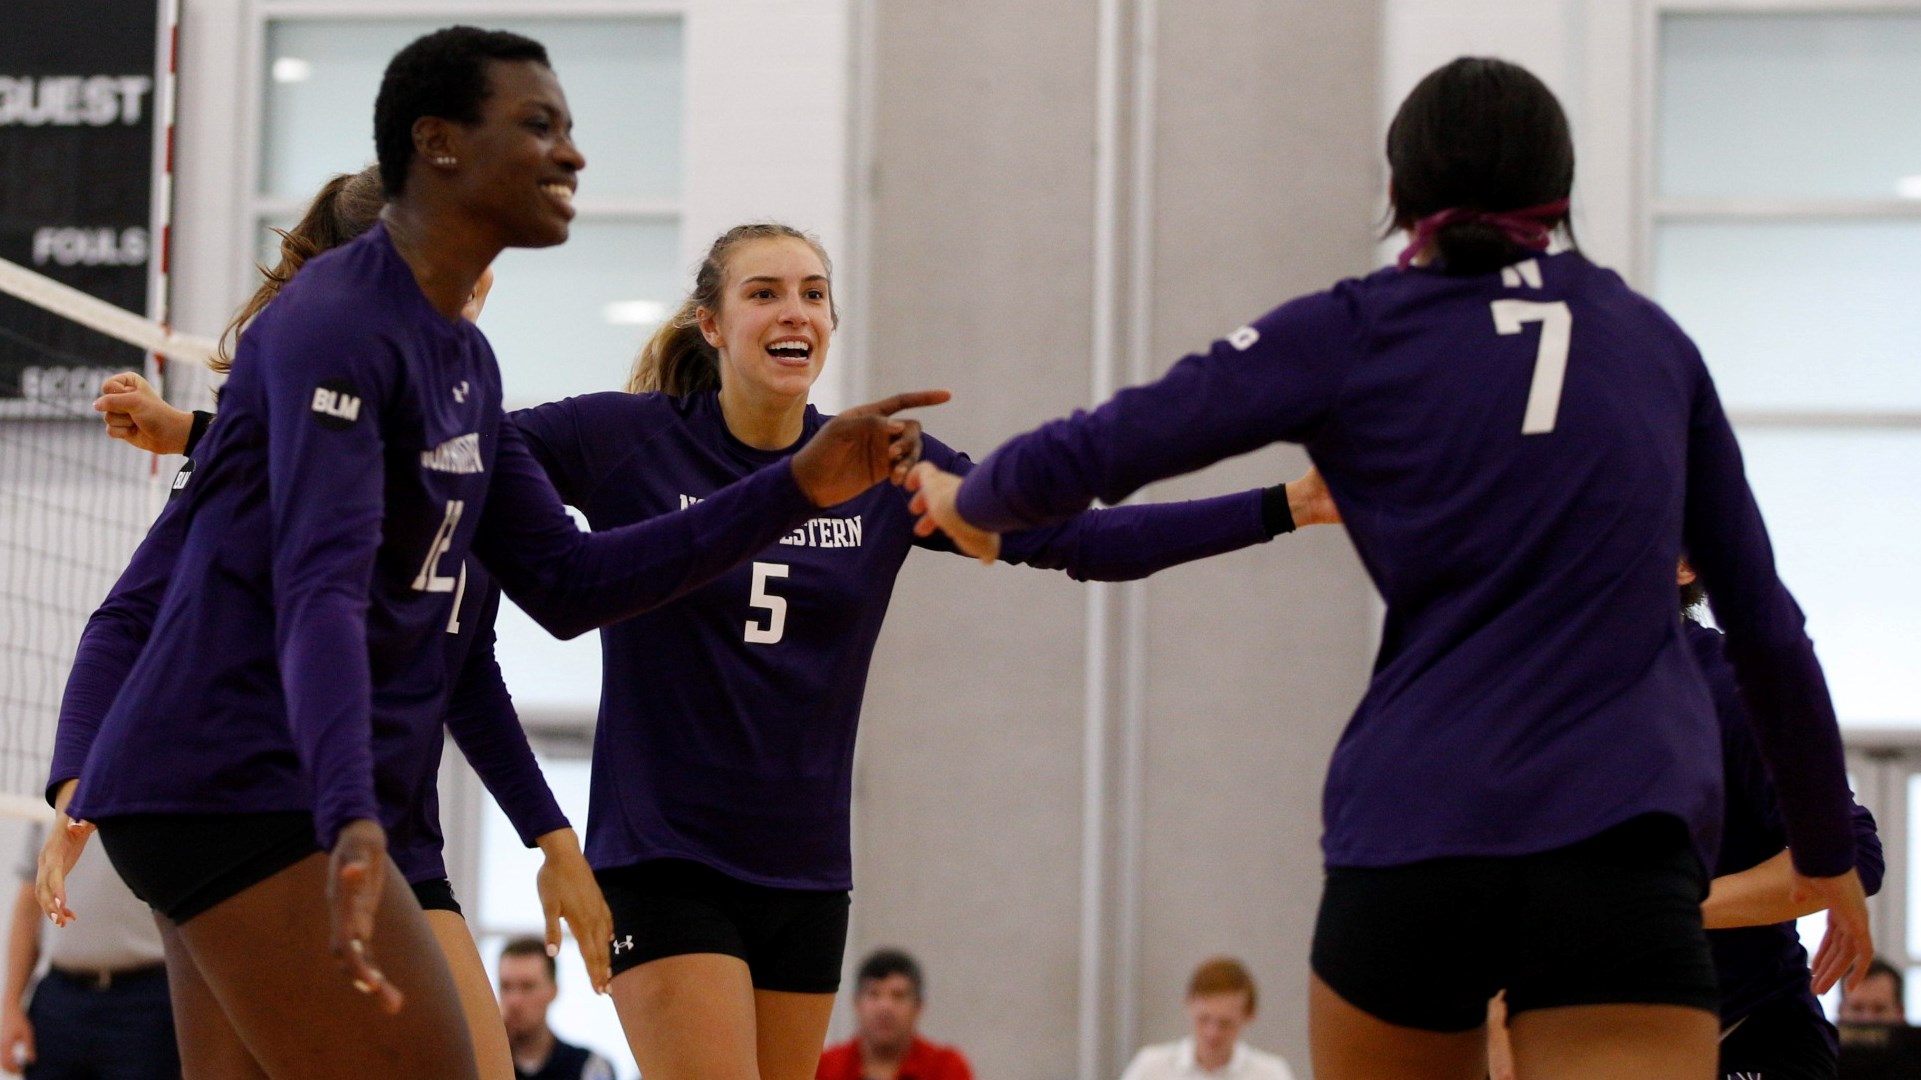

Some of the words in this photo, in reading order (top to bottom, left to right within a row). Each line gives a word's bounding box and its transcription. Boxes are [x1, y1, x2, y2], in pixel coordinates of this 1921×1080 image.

[33, 226, 148, 266] FOULS
[311, 387, 361, 422] BLM
[1490, 300, 1572, 435] 7
[411, 500, 464, 592] 12
[743, 561, 789, 645] 5
